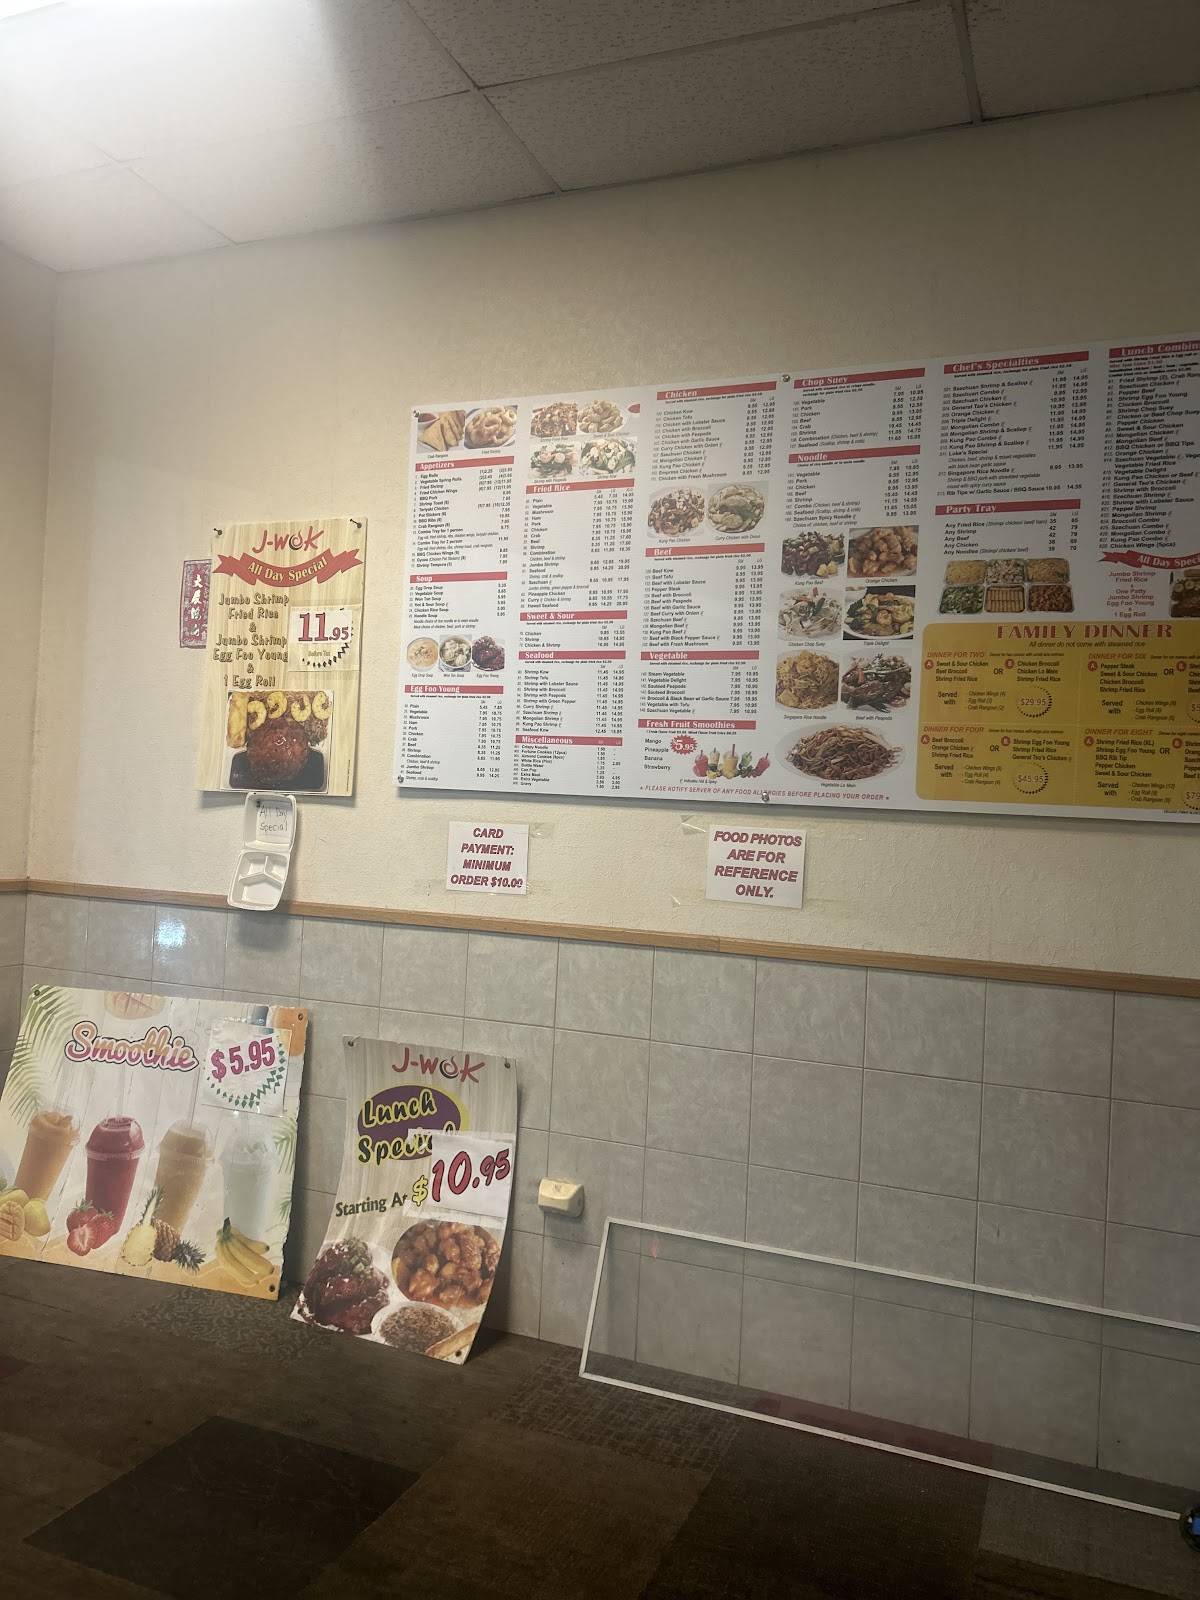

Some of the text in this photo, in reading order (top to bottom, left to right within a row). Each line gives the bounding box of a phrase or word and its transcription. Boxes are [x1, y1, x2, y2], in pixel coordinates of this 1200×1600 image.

[1121, 346, 1153, 356] Lunch
[952, 363, 982, 373] Chef's
[986, 358, 1040, 370] Specialties
[802, 376, 849, 387] Chop Suey
[665, 390, 698, 399] Chicken
[797, 453, 828, 462] Noodle
[420, 462, 455, 471] Appetizers
[533, 484, 571, 493] Fried Rice
[945, 503, 997, 515] Party Tray
[654, 548, 672, 556] Beef
[1137, 555, 1150, 564] All
[1152, 557, 1170, 567] Day
[247, 556, 328, 583] All Day Special
[218, 592, 290, 607] Jumbo Shrimp
[228, 606, 279, 620] Fried Rice
[526, 612, 575, 620] Sweet & Sour
[248, 622, 257, 633] &
[298, 612, 349, 642] 11.95
[997, 624, 1173, 639] FAMILY DINNER
[215, 633, 288, 648] Jumbo Shrimp
[212, 648, 289, 662] Egg Foo Young
[524, 651, 554, 659] Seafood
[649, 652, 688, 660] Vegetable
[246, 662, 255, 674] &
[993, 667, 1004, 675] OR
[1163, 668, 1175, 676] OR
[223, 674, 276, 689] 1 Egg Roll
[410, 685, 460, 693] Egg Foo Young
[646, 720, 736, 729] Fresh Fruit Smoothies
[1084, 728, 1112, 736] DINNER
[1112, 728, 1130, 736] FOR
[521, 735, 573, 745] Miscellaneous
[1159, 747, 1170, 755] OR
[1097, 781, 1120, 789] Served
[813, 791, 841, 799] PLACING
[259, 820, 288, 832] Special
[473, 827, 504, 839] CARD
[713, 830, 803, 847] FOOD PHOTOS
[460, 842, 515, 856] PAYMENT:
[726, 848, 786, 864] ARE FOR
[462, 859, 512, 872] MINIMUM
[713, 865, 799, 883] REFERENCE
[450, 874, 524, 888] ORDER $10.00
[735, 884, 774, 898] ONLY.
[64, 1020, 200, 1072] Smoothie
[210, 1037, 276, 1083] $5.95
[363, 1089, 437, 1128] Lunch
[335, 1191, 387, 1217] Starting
